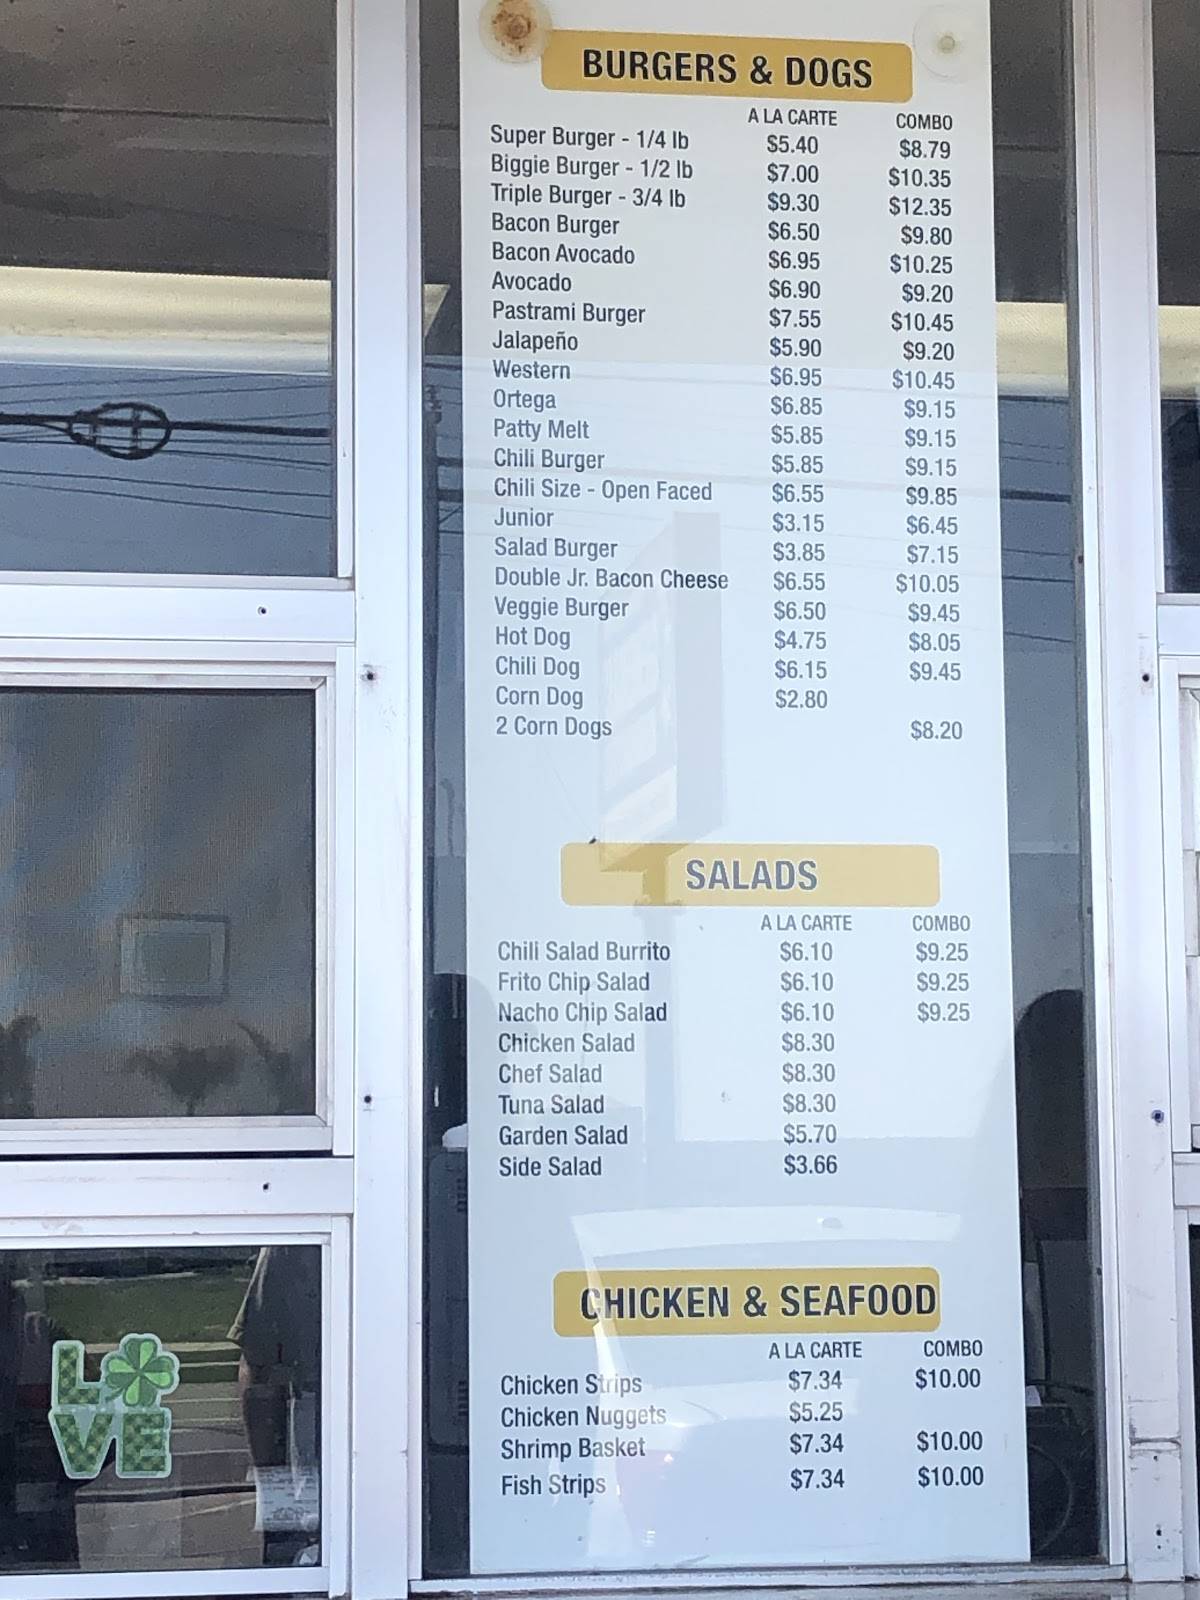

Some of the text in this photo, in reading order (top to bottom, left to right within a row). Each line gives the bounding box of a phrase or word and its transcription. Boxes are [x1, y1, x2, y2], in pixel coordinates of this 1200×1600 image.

[584, 50, 871, 88] BURGERS & DOGS
[748, 108, 837, 126] A LA CARTE
[897, 113, 952, 130] COMBO
[491, 125, 546, 147] Super
[553, 127, 615, 150] Burger
[637, 130, 665, 148] 1/4
[673, 131, 688, 149] lb
[768, 135, 818, 154] $5.40
[900, 139, 950, 158] $8.79
[492, 154, 549, 177] Biggie
[557, 156, 619, 179] Burger
[641, 160, 669, 178] 1/2
[677, 160, 692, 178] lb
[768, 163, 818, 183] $7.00
[889, 167, 951, 187] $10.35
[491, 183, 541, 206] Triple
[550, 185, 612, 208] Burger
[633, 188, 662, 206] 3/4
[670, 189, 685, 207] lb
[768, 192, 819, 212] $9.30
[890, 196, 951, 216] $12.35
[493, 213, 619, 238] Bacon Burger
[769, 221, 819, 240] $6.50
[901, 225, 952, 245] $9.80
[493, 242, 634, 264] Bacon Avocado
[769, 250, 819, 269] $6.95
[890, 254, 952, 273] $10.25
[492, 272, 571, 291] Avocado
[769, 279, 820, 298] $6.90
[903, 283, 952, 303] $9.20
[493, 301, 645, 326] Pastrami Burger
[770, 308, 820, 328] $7.55
[892, 312, 953, 331] $10.45
[493, 330, 577, 353] Jalapeño
[770, 337, 821, 357] $5.90
[904, 341, 954, 360] $9.20
[493, 360, 570, 379] Western
[771, 366, 821, 386] $6.95
[893, 369, 954, 389] $10.45
[494, 389, 556, 412] Ortega
[771, 396, 822, 415] $6.85
[905, 399, 955, 419] $9.15
[495, 419, 589, 442] Patty Melt
[772, 424, 823, 444] $5.85
[905, 428, 956, 447] $9.15
[495, 448, 605, 472] Chili Burger
[772, 455, 823, 474] $5.85
[906, 457, 956, 476] $9.15
[495, 478, 534, 496] Chili
[542, 479, 580, 497] Size
[602, 480, 649, 502] Open
[657, 481, 711, 500] Faced
[773, 483, 823, 503] $6.55
[907, 487, 956, 505] $9.85
[495, 508, 554, 526] Junior
[773, 512, 824, 533] $3.15
[907, 515, 957, 535] $6.45
[495, 537, 618, 561] Salad Burger
[773, 542, 825, 561] $3.85
[907, 545, 958, 564] $7.15
[496, 567, 727, 589] Double Jr. Bacon Cheese
[774, 571, 825, 591] $6.55
[896, 573, 959, 593] $10.05
[495, 596, 629, 620] Veggie Burger
[774, 600, 825, 621] $6.50
[908, 602, 959, 622] $9.45
[496, 626, 570, 650] Hot Dog
[775, 630, 826, 650] $4.75
[909, 632, 960, 652] $8.05
[496, 656, 579, 680] Chili Dog
[775, 659, 827, 679] $6.15
[910, 661, 960, 681] $9.45
[496, 686, 582, 709] Corn Dog
[776, 689, 827, 708] $2.80
[497, 716, 611, 739] 2 Corn Dogs
[911, 720, 962, 740] $8.20
[687, 860, 817, 890] SALADS
[761, 915, 851, 930] A LA CARTE
[913, 915, 970, 931] COMBO
[498, 941, 670, 960] Chili Salad Burrito
[780, 941, 832, 962] $6.10
[916, 942, 968, 963] $9.25
[499, 972, 649, 995] Frito Chip Salad
[781, 971, 833, 992] $6.10
[917, 972, 969, 992] $9.25
[499, 1002, 666, 1025] Nacho Chip Salad
[781, 1001, 834, 1023] $6.10
[918, 1002, 969, 1023] $9.25
[499, 1033, 634, 1052] Chicken Salad
[782, 1032, 834, 1053] $8.30
[499, 1064, 601, 1083] Chef Salad
[783, 1063, 835, 1084] $8.30
[498, 1095, 603, 1114] Tuna Salad
[783, 1093, 835, 1114] $8.30
[500, 1125, 627, 1145] Garden Salad
[784, 1124, 836, 1145] $5.70
[500, 1157, 601, 1176] Side Salad
[784, 1154, 837, 1175] $3.66
[582, 1285, 935, 1319] CHICKEN & SEAFOOD
[769, 1341, 861, 1358] A LA CARTE
[924, 1340, 982, 1357] COMBO
[502, 1374, 642, 1398] Chicken Strips
[789, 1370, 842, 1390] $7.34
[916, 1368, 980, 1389] $10.00
[502, 1405, 666, 1429] Chicken Nuggets
[790, 1402, 842, 1423] $5.25
[502, 1438, 645, 1462] Shrimp Basket
[790, 1433, 843, 1454] $7.34
[917, 1431, 982, 1452] $10.00
[502, 1474, 605, 1498] Fish Strips
[791, 1469, 844, 1491] $7.34
[919, 1466, 983, 1488] $10.00
